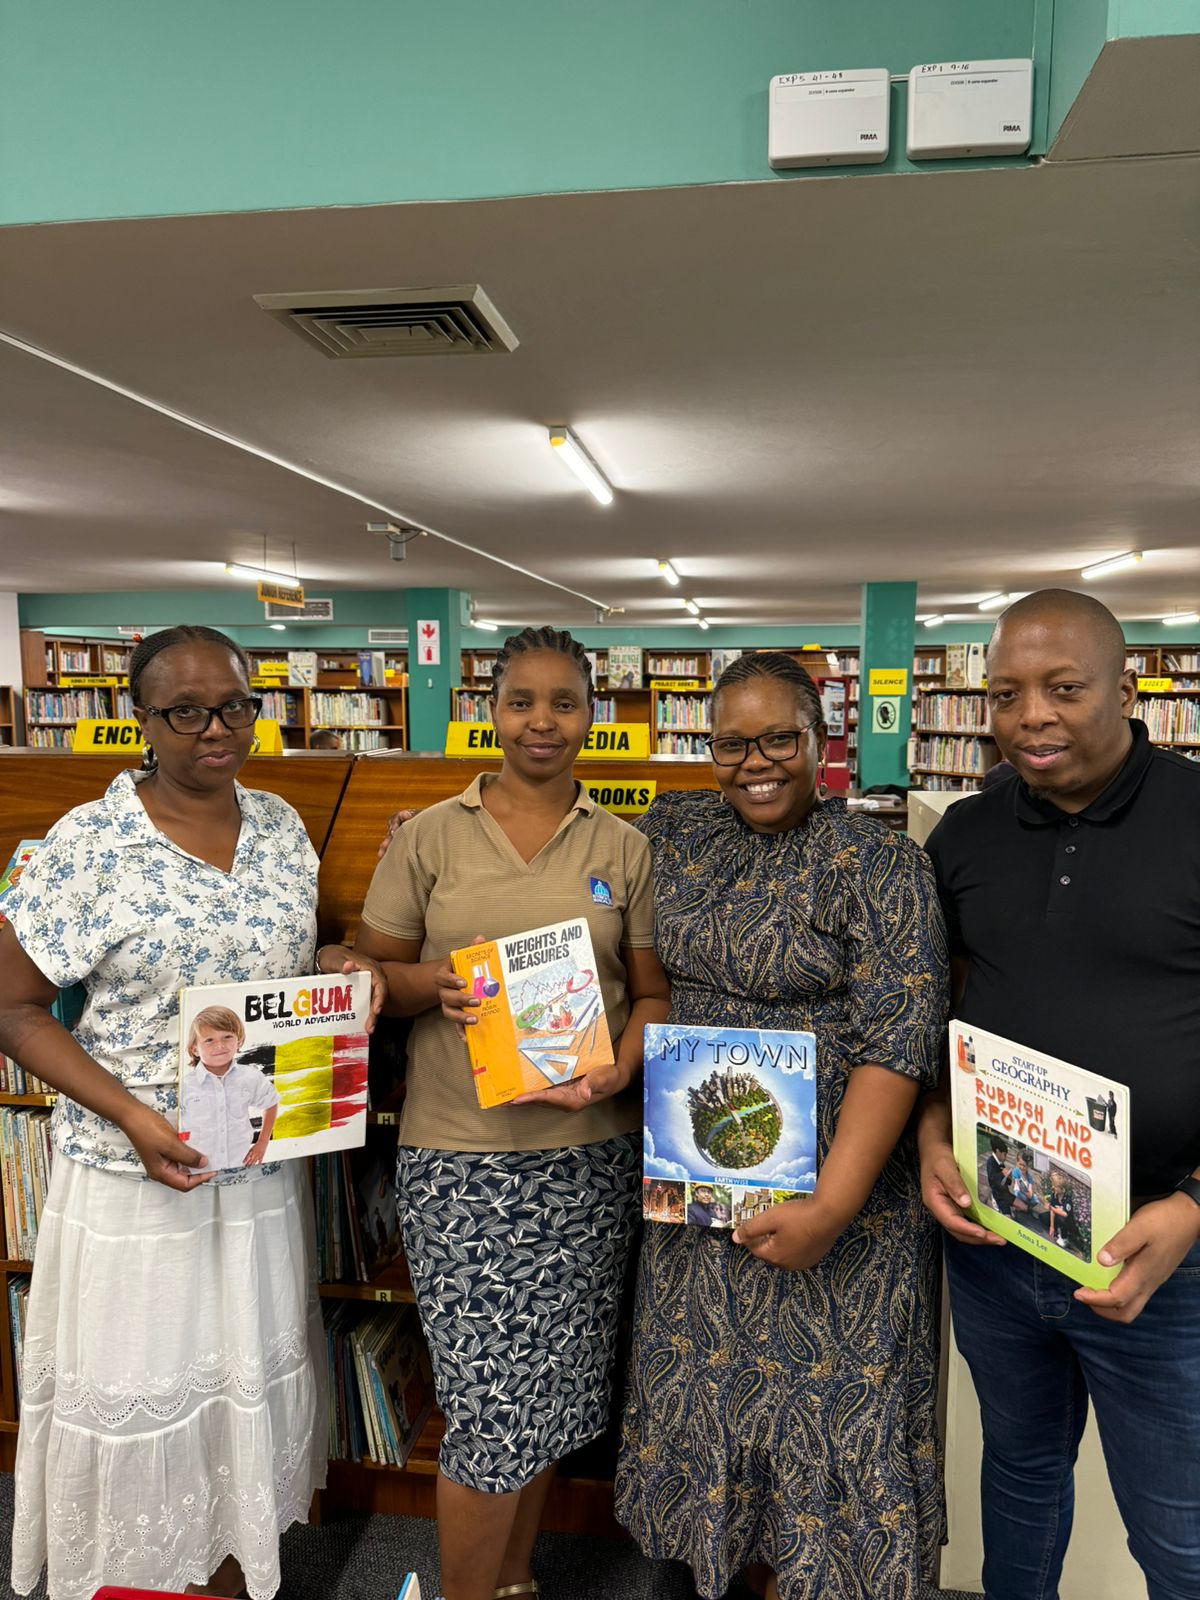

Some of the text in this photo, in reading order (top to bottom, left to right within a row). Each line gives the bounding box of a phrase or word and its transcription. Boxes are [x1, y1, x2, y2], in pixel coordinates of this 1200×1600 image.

[589, 788, 650, 805] BOOKS
[505, 925, 583, 958] WEIGHTS AND
[508, 944, 570, 974] MEASURES
[245, 984, 353, 1022] BELGIUM
[272, 1012, 356, 1029] WORLD ADVENTURES
[660, 1037, 808, 1069] MY TOWN
[1012, 1056, 1048, 1077] START-UP
[992, 1058, 1071, 1102] GEOGRAPHY
[975, 1077, 1092, 1144] RUBBISH AND
[975, 1096, 1093, 1169] RECYCLING
[1016, 1229, 1048, 1251] Anna Lee
[380, 1291, 388, 1302] R
